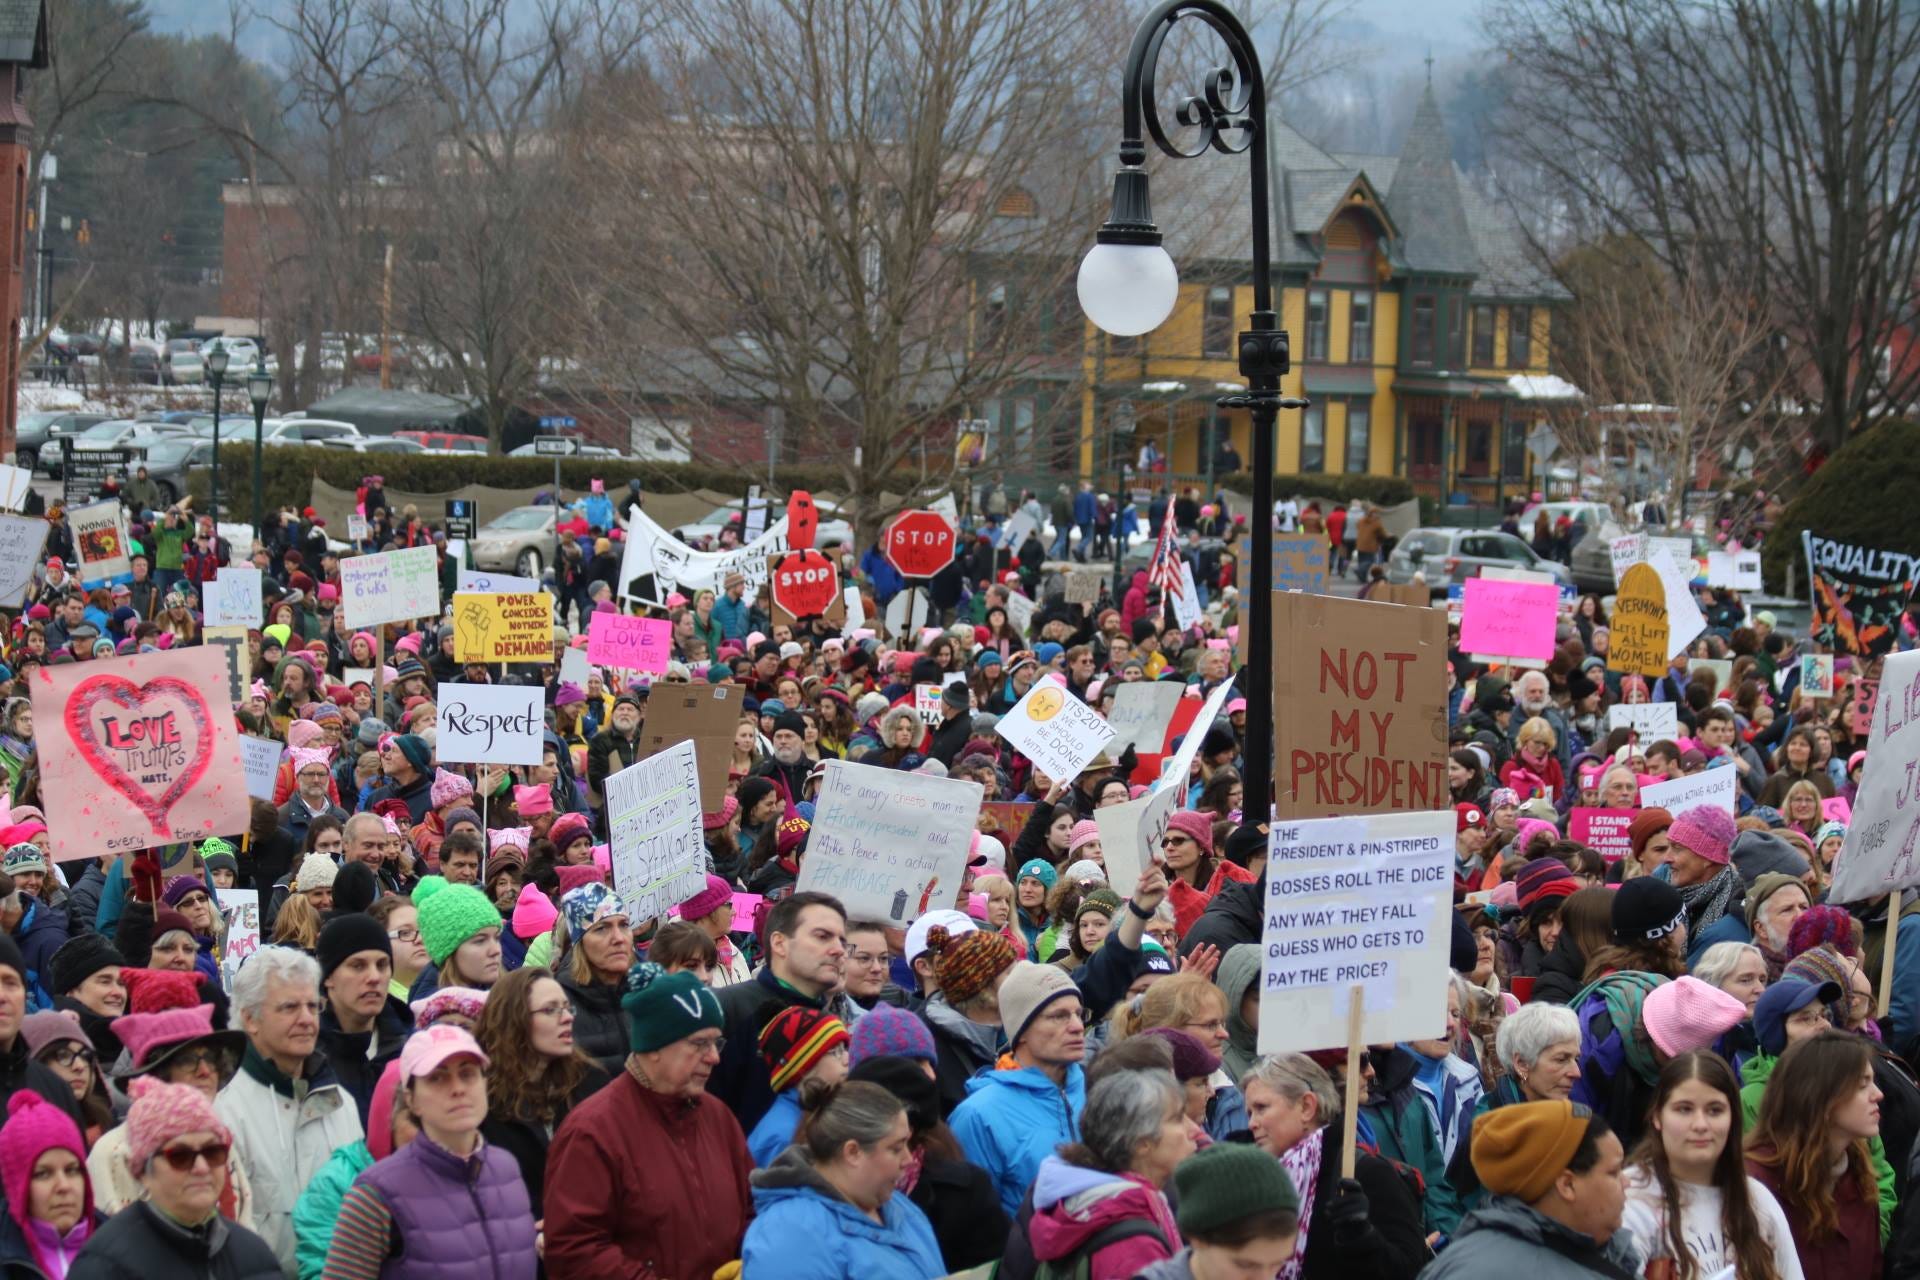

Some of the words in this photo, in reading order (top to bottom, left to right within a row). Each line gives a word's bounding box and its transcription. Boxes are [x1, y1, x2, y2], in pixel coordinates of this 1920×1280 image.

[101, 453, 124, 461] STREET
[78, 517, 115, 531] WOMEN
[896, 530, 948, 546] STOP
[1812, 537, 1920, 582] EQUALITY
[781, 568, 829, 586] STOP
[355, 582, 364, 597] 6
[497, 595, 536, 606] POWER
[502, 607, 547, 619] CONCEDES
[1616, 598, 1667, 620] VERMONT
[509, 621, 548, 631] NOTHING
[612, 617, 651, 632] LOCAL
[604, 630, 655, 648] LOVE
[1622, 635, 1648, 647] ALL
[594, 643, 659, 664] BRIGADE
[1610, 645, 1665, 667] WOMEN
[1320, 647, 1417, 703] NOT
[100, 711, 181, 750] LOVE
[442, 700, 541, 753] Respect
[1061, 713, 1075, 728] WE
[1065, 699, 1085, 718] ITS
[1081, 712, 1116, 741] 2017
[1049, 721, 1084, 751] SHOULD
[1330, 709, 1394, 756] MY
[1023, 736, 1045, 757] WITH
[1047, 757, 1067, 776] THIS
[1037, 727, 1050, 741] BE
[1049, 738, 1084, 769] DONE
[829, 765, 851, 796] The
[858, 787, 890, 812] angry
[932, 801, 951, 811] man
[955, 804, 965, 814] is
[1291, 749, 1446, 810] PRESIDENT
[681, 749, 698, 812] TRUST
[690, 812, 703, 875] WOMEN
[1589, 816, 1593, 825] I
[1595, 816, 1631, 826] STAND
[824, 805, 920, 841] #notmypresident
[928, 832, 949, 845] and
[1275, 828, 1299, 842] THE
[1589, 826, 1617, 836] WITH
[107, 836, 145, 850] every
[816, 834, 846, 856] Mike
[851, 838, 879, 861] Pence
[888, 851, 897, 864] is
[905, 857, 939, 872] actual
[1272, 844, 1343, 860] PRESIDENT
[1347, 843, 1356, 856] &
[1360, 837, 1439, 857] PIN-STRIPED
[1588, 837, 1631, 846] PLANNE
[636, 832, 677, 889] SPEAK
[811, 862, 897, 895] #GARBAGE
[1271, 876, 1331, 896] BOSSES
[1335, 872, 1372, 889] ROLL
[1377, 868, 1404, 885] THE
[1411, 866, 1445, 883] DICE
[637, 871, 691, 924] GENEROUS
[1268, 914, 1299, 931] ANY
[1302, 911, 1335, 927] WAY
[1341, 907, 1378, 924] THEY
[1382, 904, 1416, 920] FALL
[1269, 939, 1319, 958] GUESS
[1323, 934, 1358, 952] WHO
[1363, 933, 1401, 949] GETS
[1405, 930, 1424, 945] TO
[1268, 972, 1297, 988] PAY
[1300, 968, 1328, 983] THE
[1336, 962, 1388, 981] PRICE?
